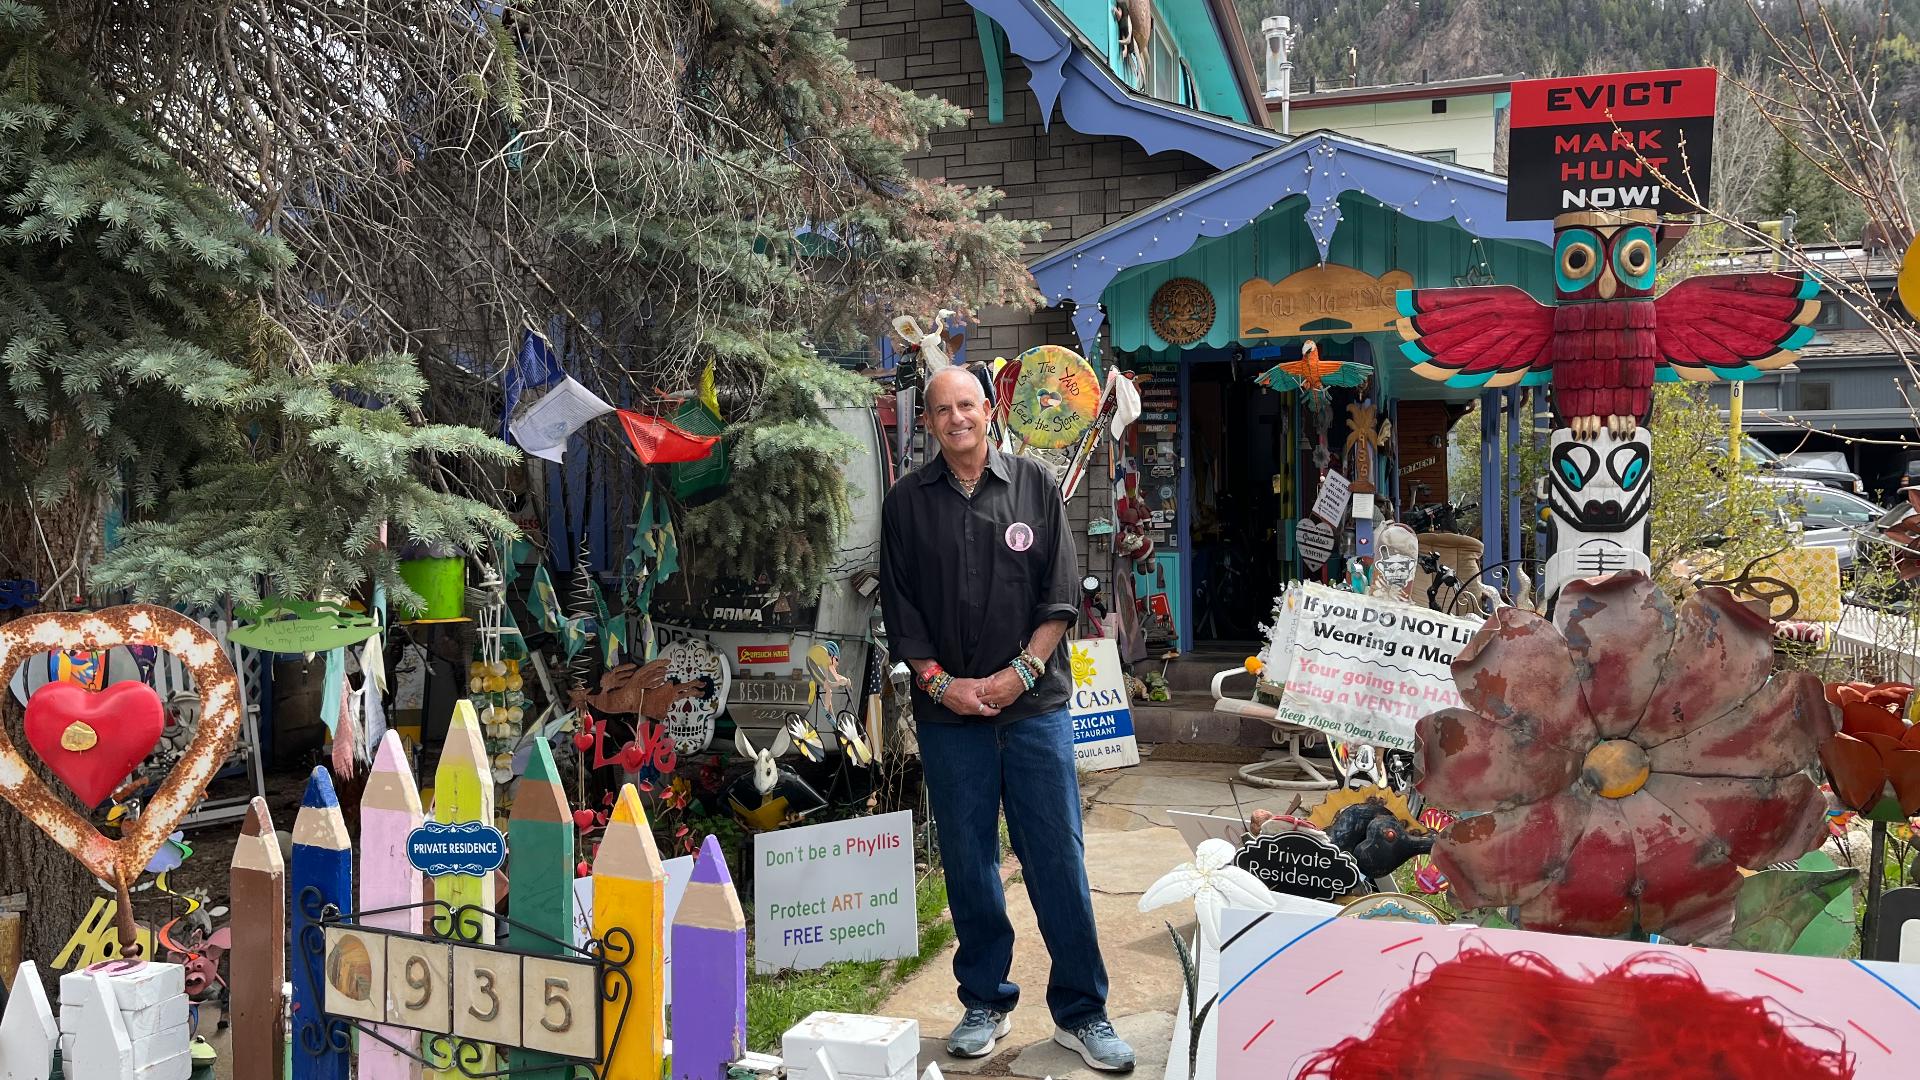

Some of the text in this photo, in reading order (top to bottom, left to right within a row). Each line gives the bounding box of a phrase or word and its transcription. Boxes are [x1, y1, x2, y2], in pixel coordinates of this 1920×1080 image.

[1547, 80, 1682, 111] EVICT
[1555, 130, 1663, 155] MARK
[1561, 158, 1669, 181] HUNT
[1562, 185, 1660, 209] NOW!
[1256, 294, 1295, 317] TAJ
[1309, 290, 1338, 314] MA
[1038, 361, 1056, 374] The
[1059, 366, 1080, 396] YARD
[1011, 400, 1080, 433] Keep the Signs
[713, 607, 763, 621] POMA
[1303, 596, 1476, 644] If you DO NOT Li
[273, 622, 322, 635] Welcome
[300, 635, 315, 646] pad
[1313, 621, 1397, 657] Wearing
[1402, 645, 1413, 657] a
[1418, 644, 1456, 666] Ma
[740, 682, 796, 701] BEST DAY
[1286, 680, 1334, 704] using
[1337, 692, 1348, 704] a
[1299, 656, 1460, 705] Your going to HAT
[1076, 689, 1121, 708] CASA
[1072, 715, 1115, 730] EXICAN
[1280, 707, 1306, 724] Keep
[1309, 714, 1341, 734] Aspen
[1378, 730, 1404, 748] Keep
[1074, 745, 1121, 759] EQUILA BAR
[413, 842, 498, 854] PRIVATE RESIDENCE
[766, 833, 900, 867] Don't be a Phyllis
[1267, 843, 1331, 869] Private
[1249, 860, 1344, 891] Residence
[770, 888, 898, 920] Protect ART and
[784, 919, 885, 946] FREE speech
